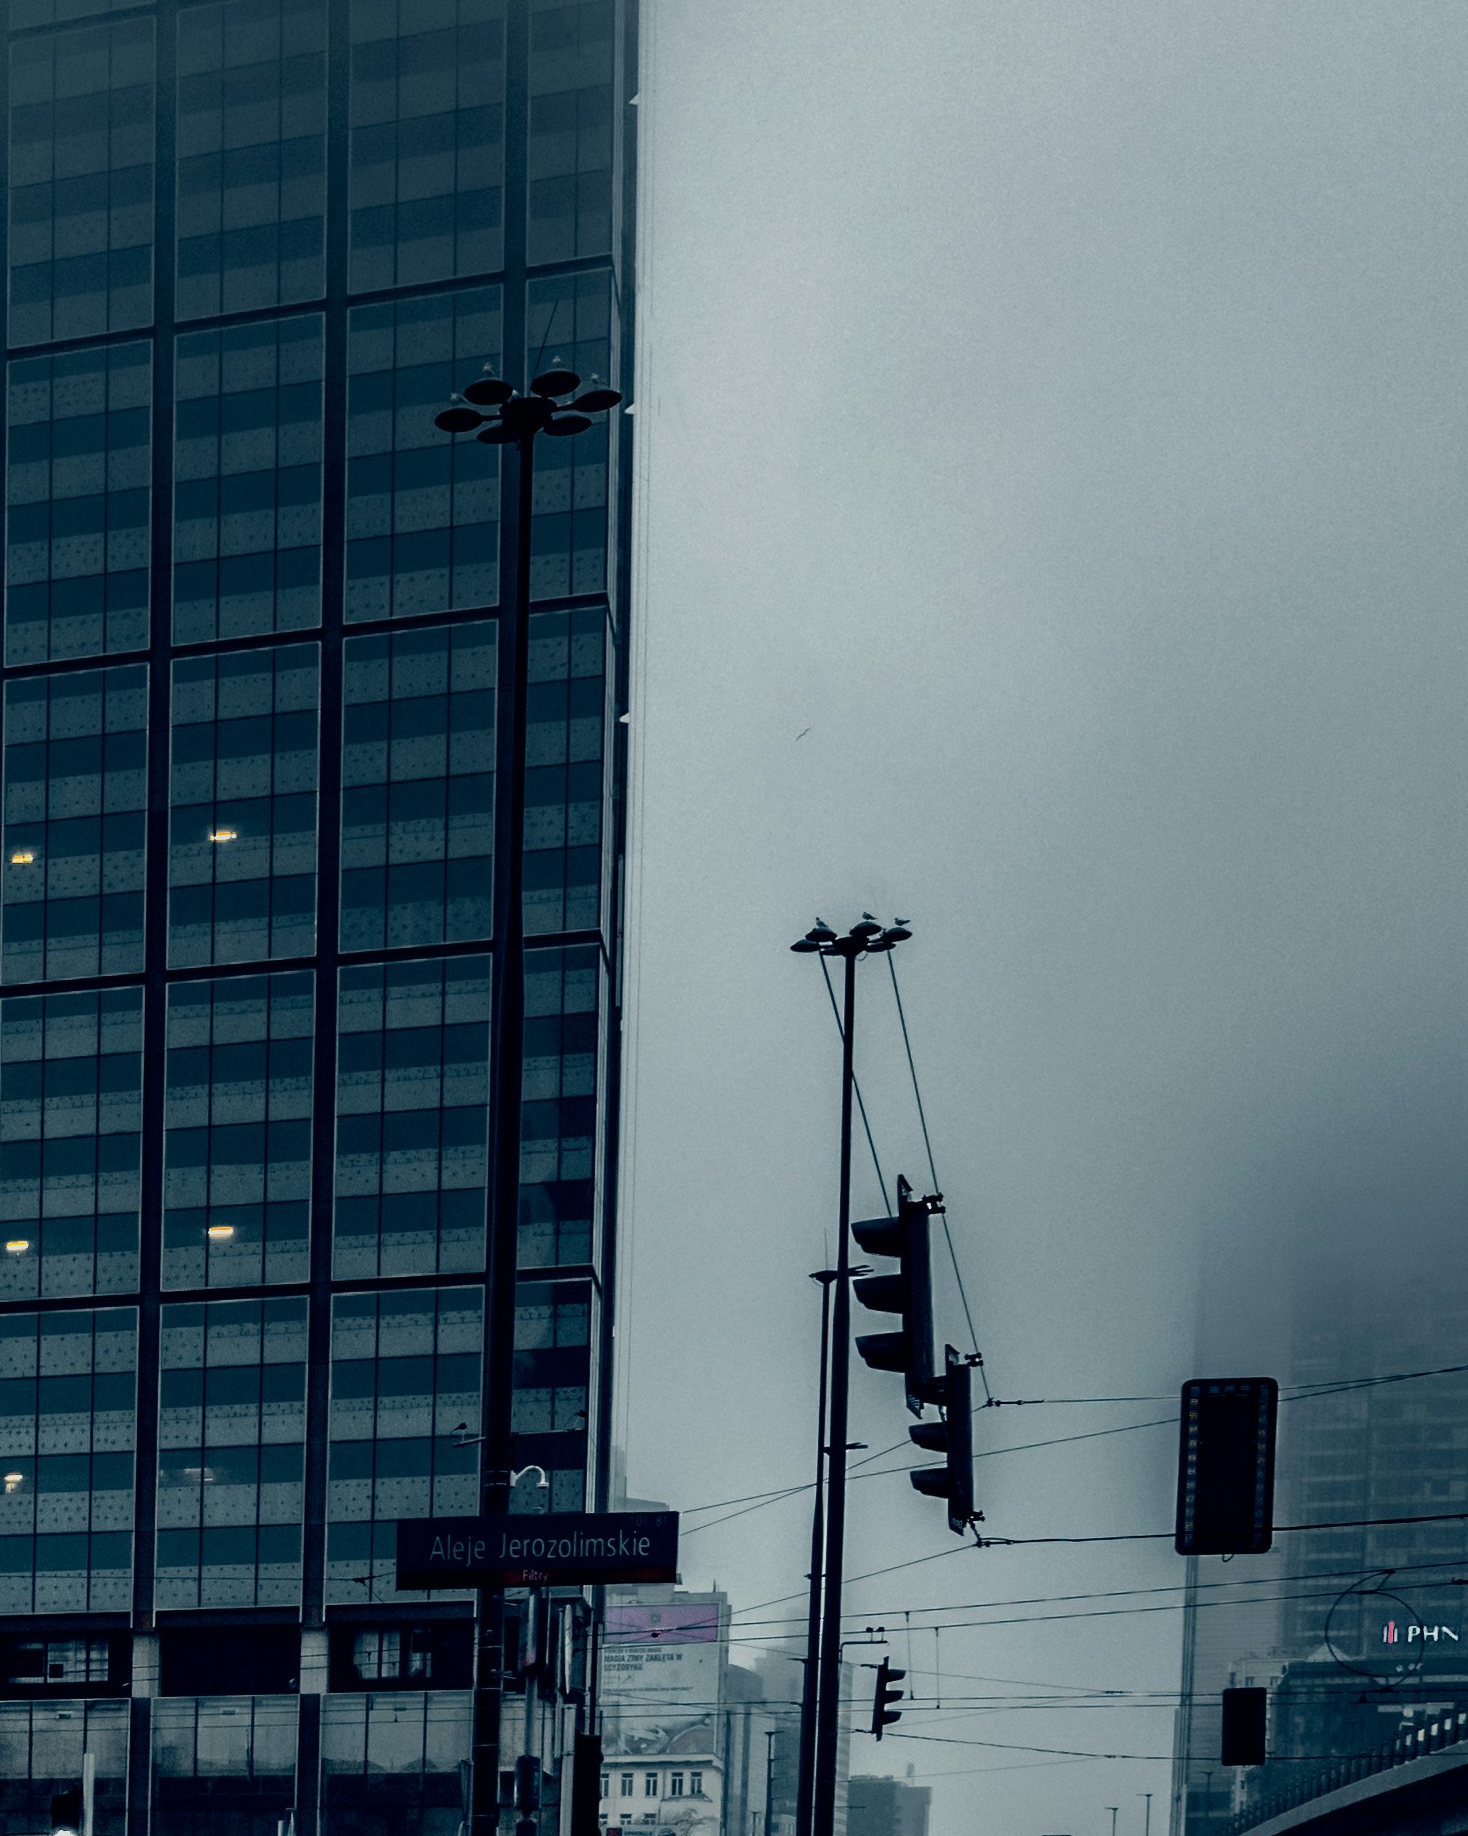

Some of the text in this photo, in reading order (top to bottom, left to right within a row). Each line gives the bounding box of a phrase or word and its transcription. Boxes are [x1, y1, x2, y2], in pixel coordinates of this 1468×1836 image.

[429, 1530, 651, 1567] Aleje Jerozolimskie
[522, 1568, 549, 1583] Filtry
[1407, 1625, 1459, 1643] PHN
